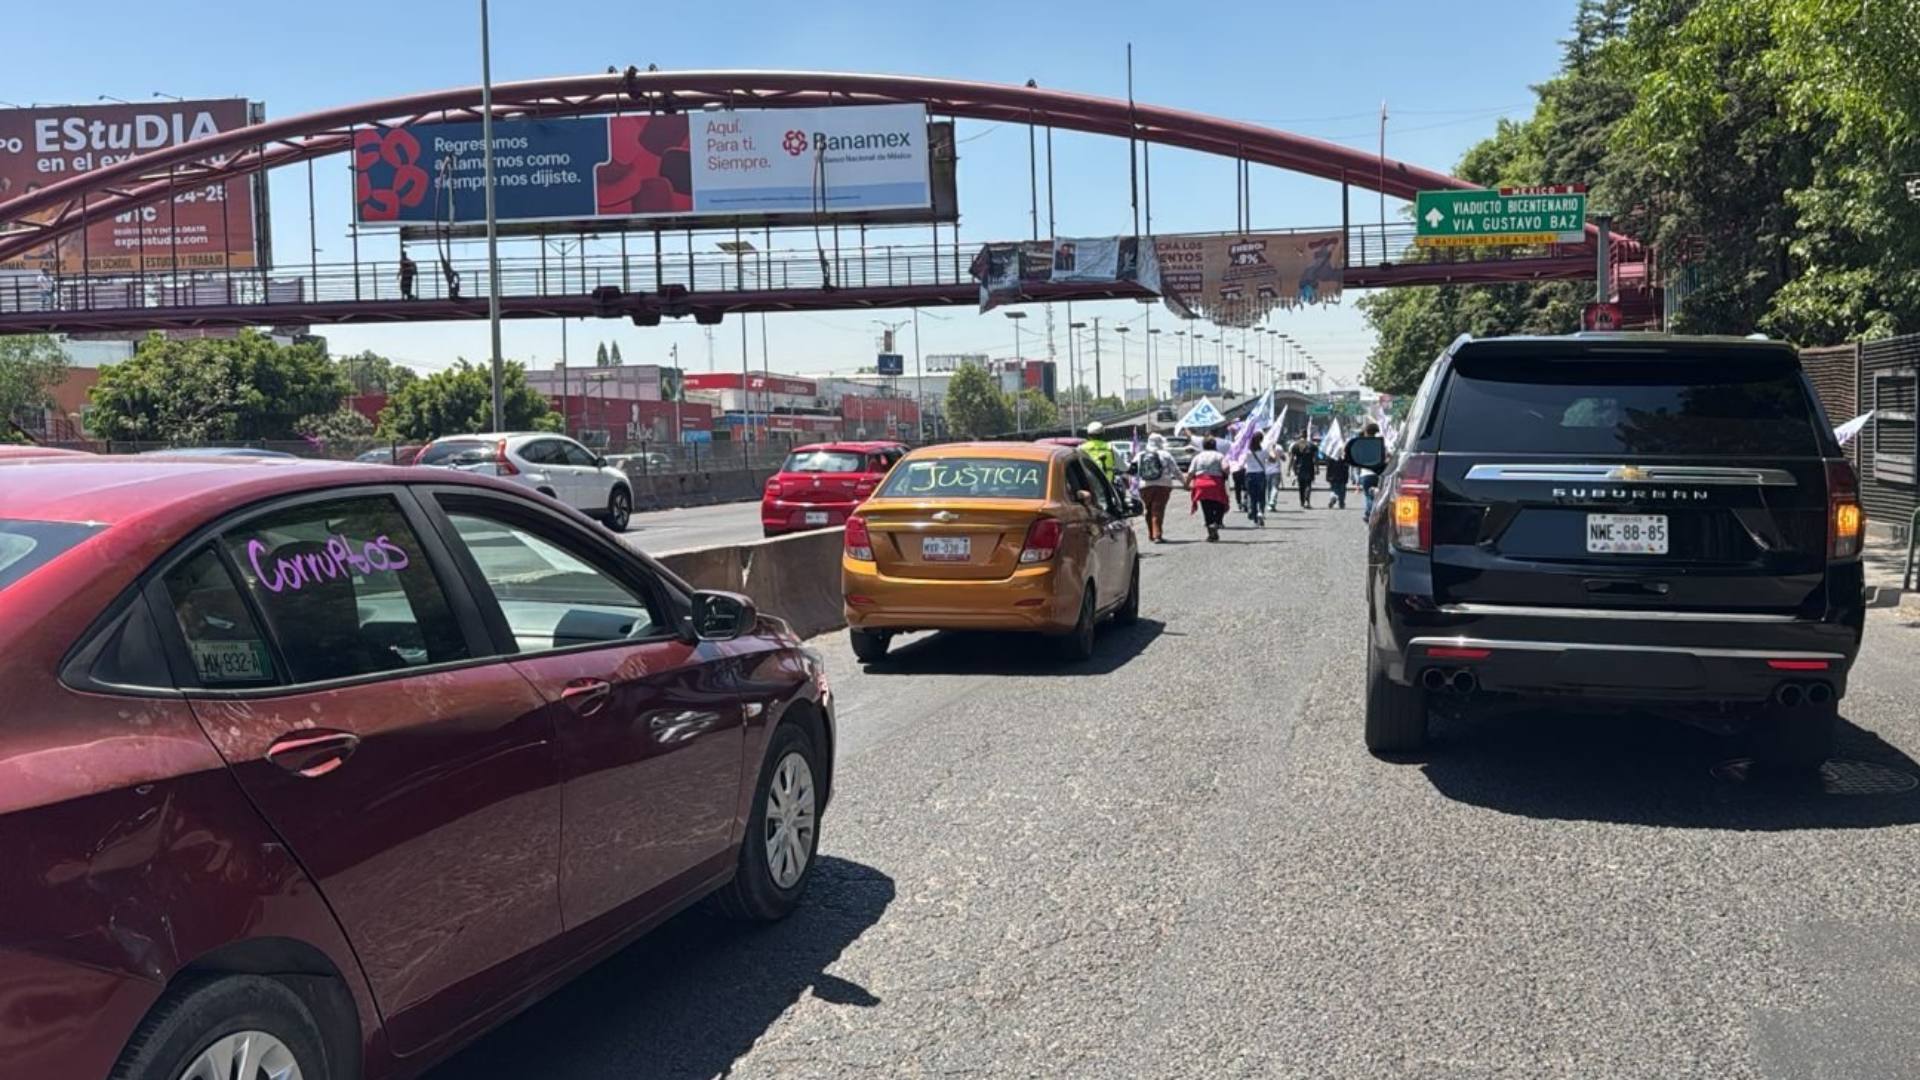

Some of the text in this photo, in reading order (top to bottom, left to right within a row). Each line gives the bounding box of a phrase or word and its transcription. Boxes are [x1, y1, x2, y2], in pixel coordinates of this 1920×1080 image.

[707, 136, 756, 152] Para ti.
[813, 131, 911, 150] Banamex
[37, 156, 65, 172] en
[73, 152, 92, 172] el
[526, 153, 570, 167] como
[708, 155, 771, 172] Siempre.
[500, 174, 528, 186] nos
[530, 170, 581, 187] dijiste.
[1453, 198, 1578, 214] VIADUCTO BICENTENARIO
[1453, 214, 1577, 231] VIA GUSTAVO BAZ
[912, 464, 1039, 491] JUSTICIA
[1552, 488, 1708, 499] SUBURBAN
[1590, 524, 1665, 541] NWE-88-85
